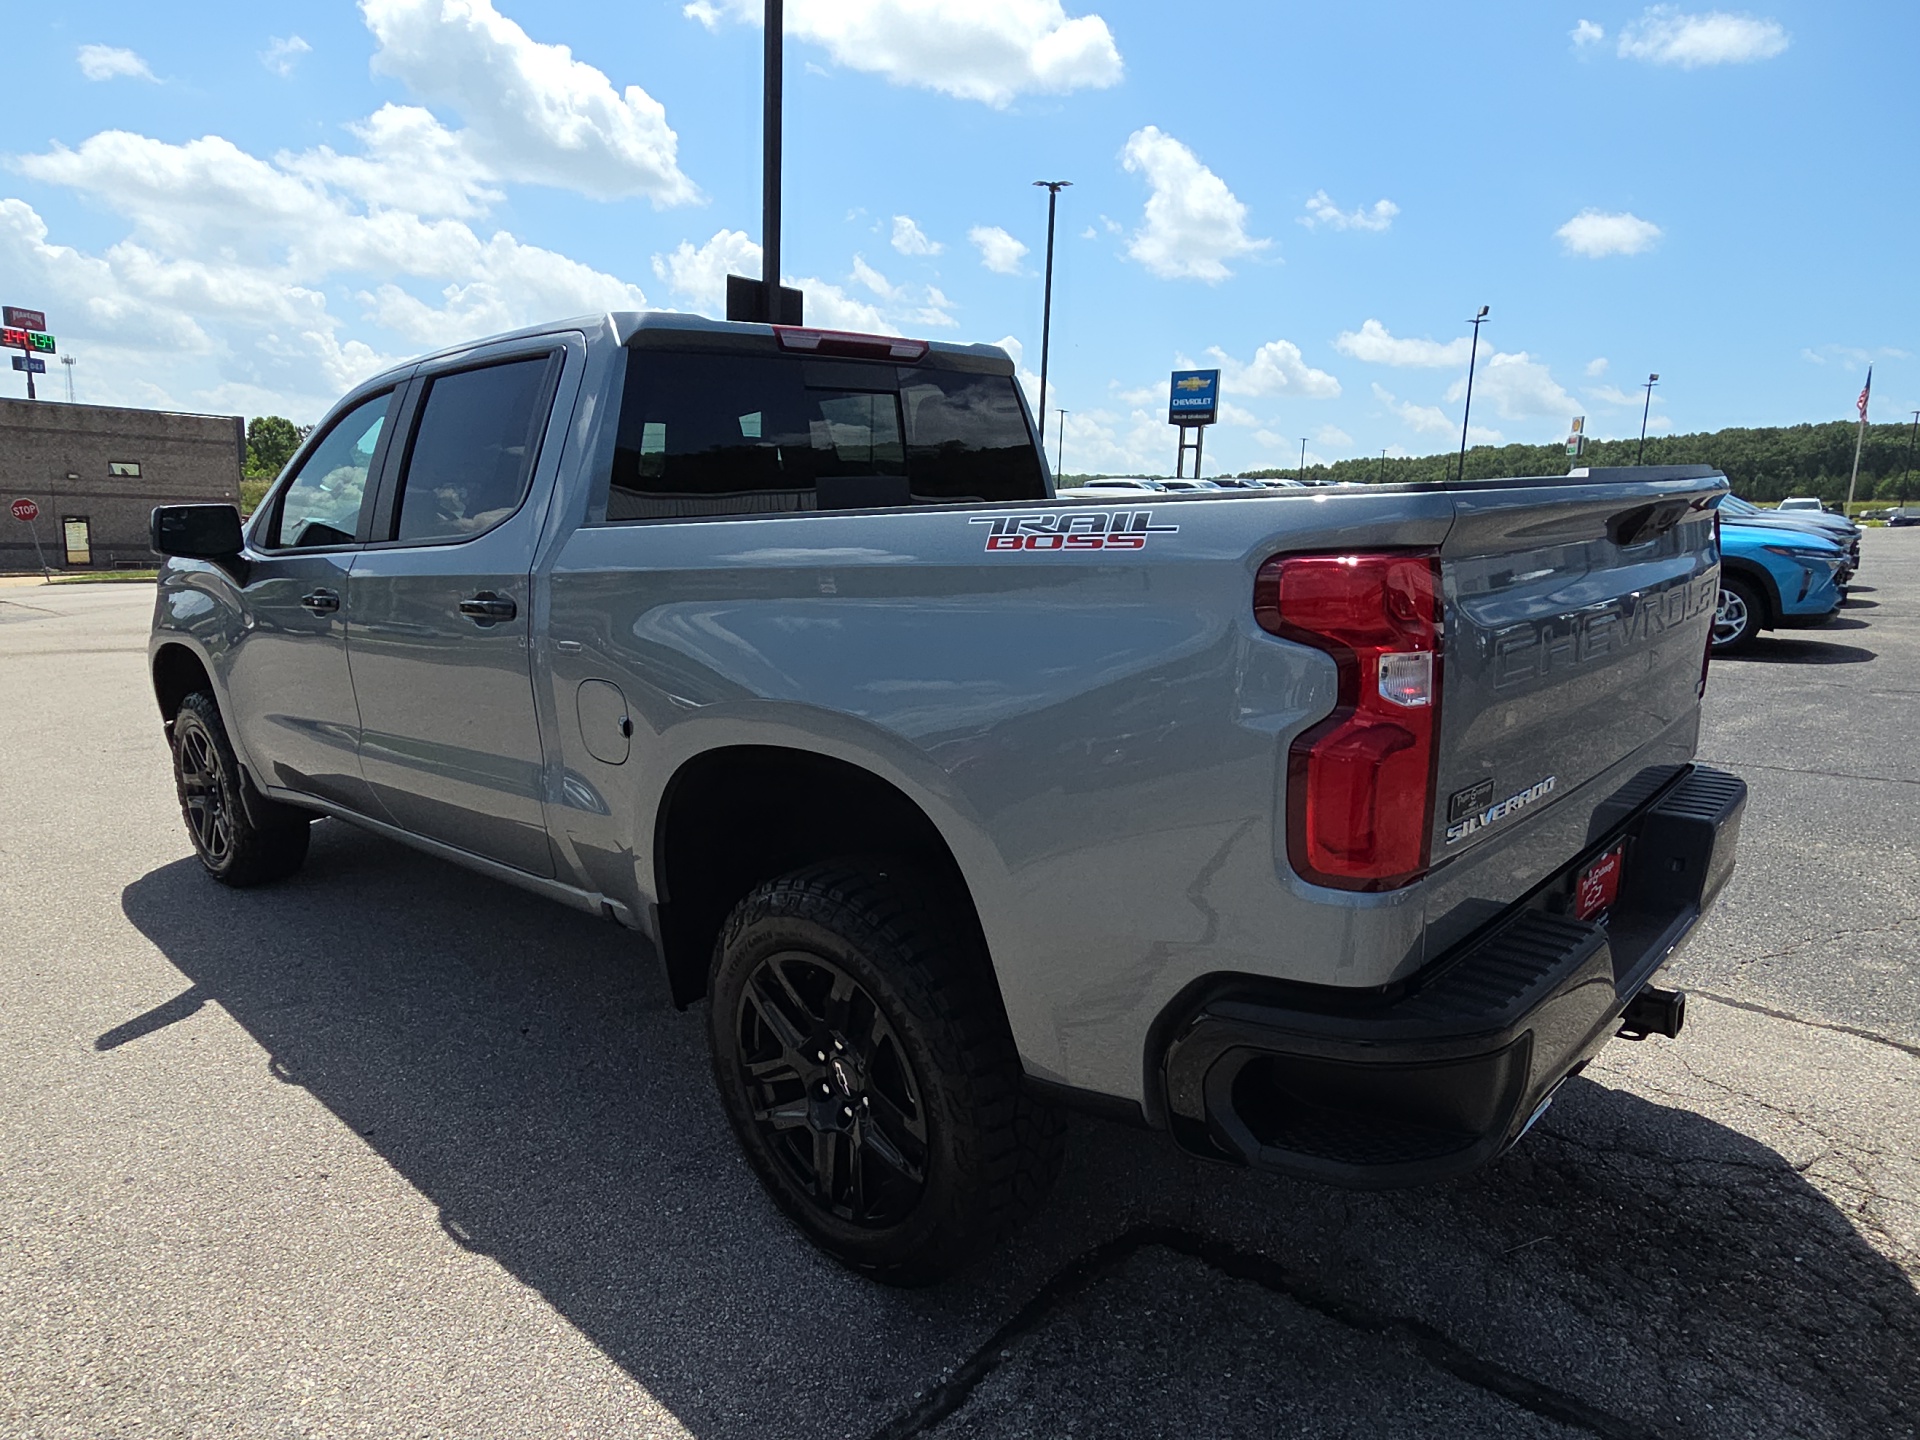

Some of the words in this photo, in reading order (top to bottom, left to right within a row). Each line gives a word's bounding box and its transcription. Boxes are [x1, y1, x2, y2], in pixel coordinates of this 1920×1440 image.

[1172, 397, 1212, 407] CHEVROLET
[13, 505, 36, 516] STOP
[968, 510, 1180, 535] TRAIL
[984, 532, 1149, 552] BOSS
[1445, 776, 1557, 845] SILVERADO
